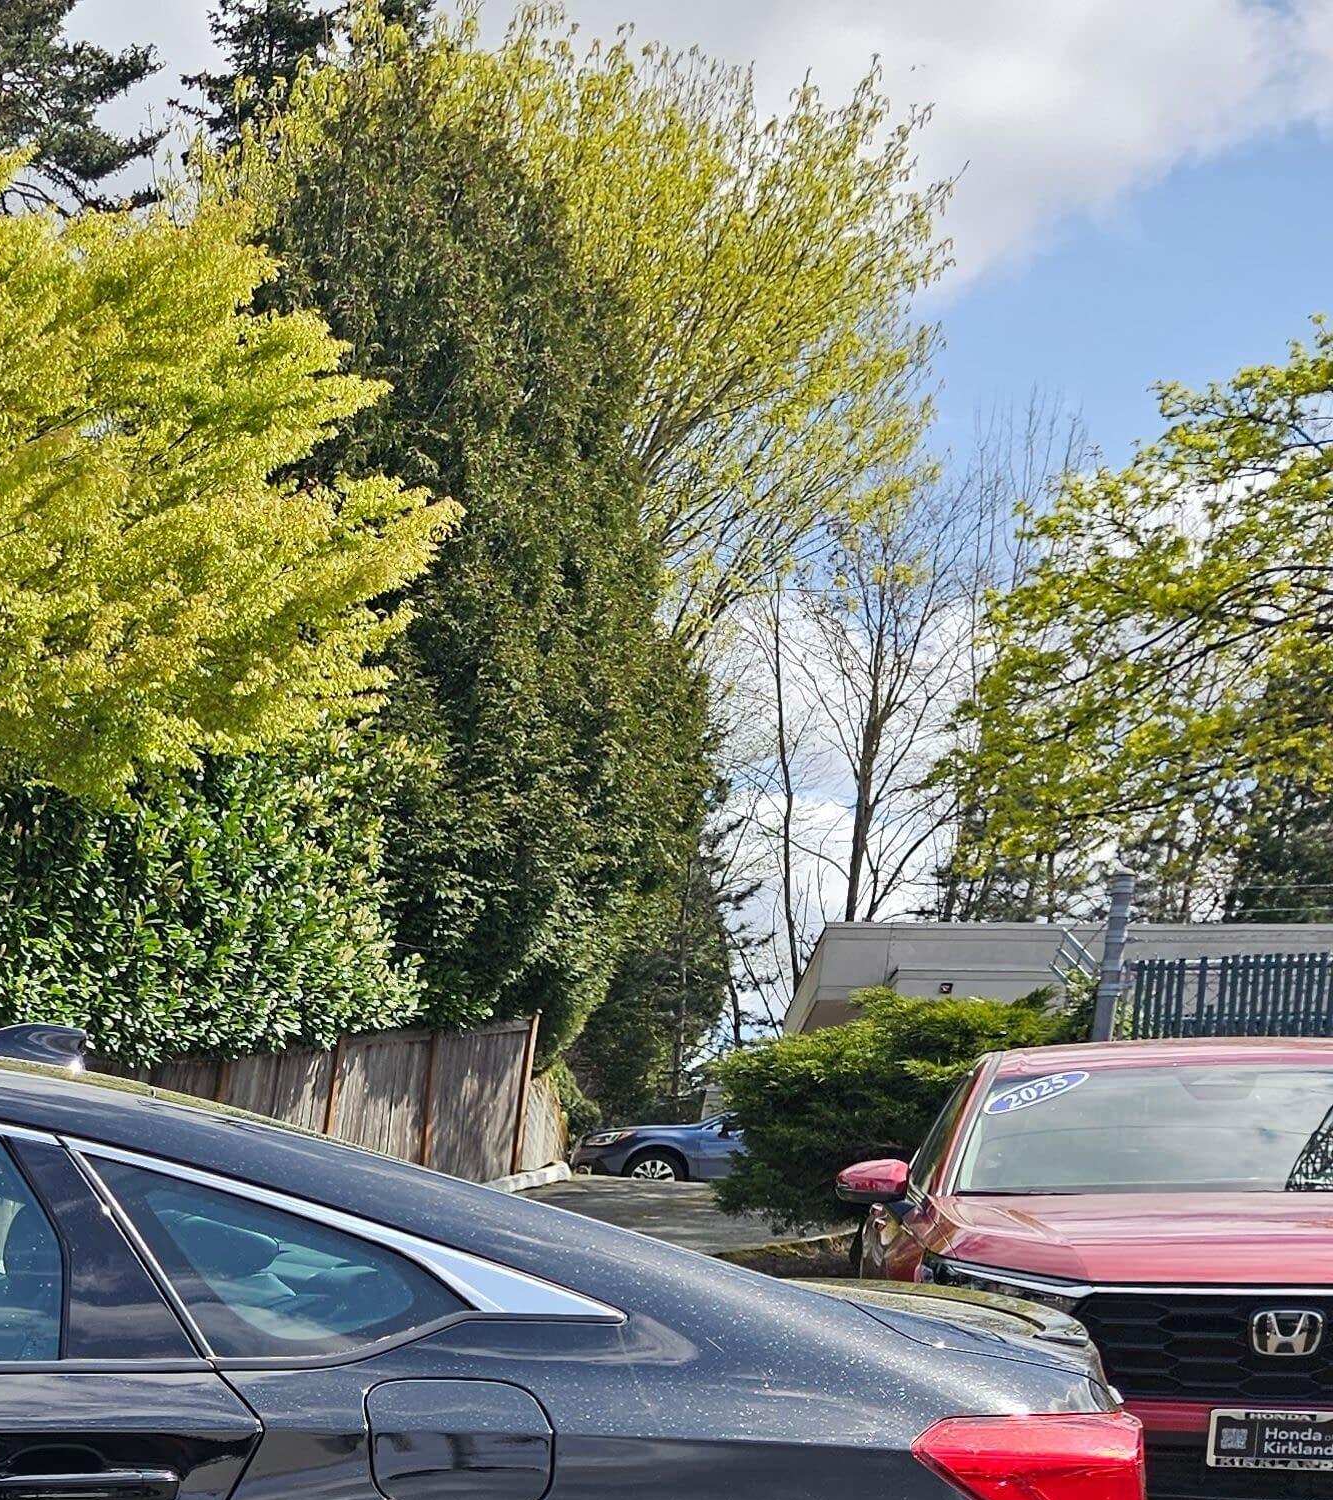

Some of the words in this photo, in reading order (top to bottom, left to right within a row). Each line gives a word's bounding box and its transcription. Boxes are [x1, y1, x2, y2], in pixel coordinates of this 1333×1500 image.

[1003, 1075, 1069, 1109] 2025
[1249, 1413, 1313, 1421] HONDA
[1265, 1427, 1322, 1441] Honda
[1263, 1441, 1333, 1455] Kirkland
